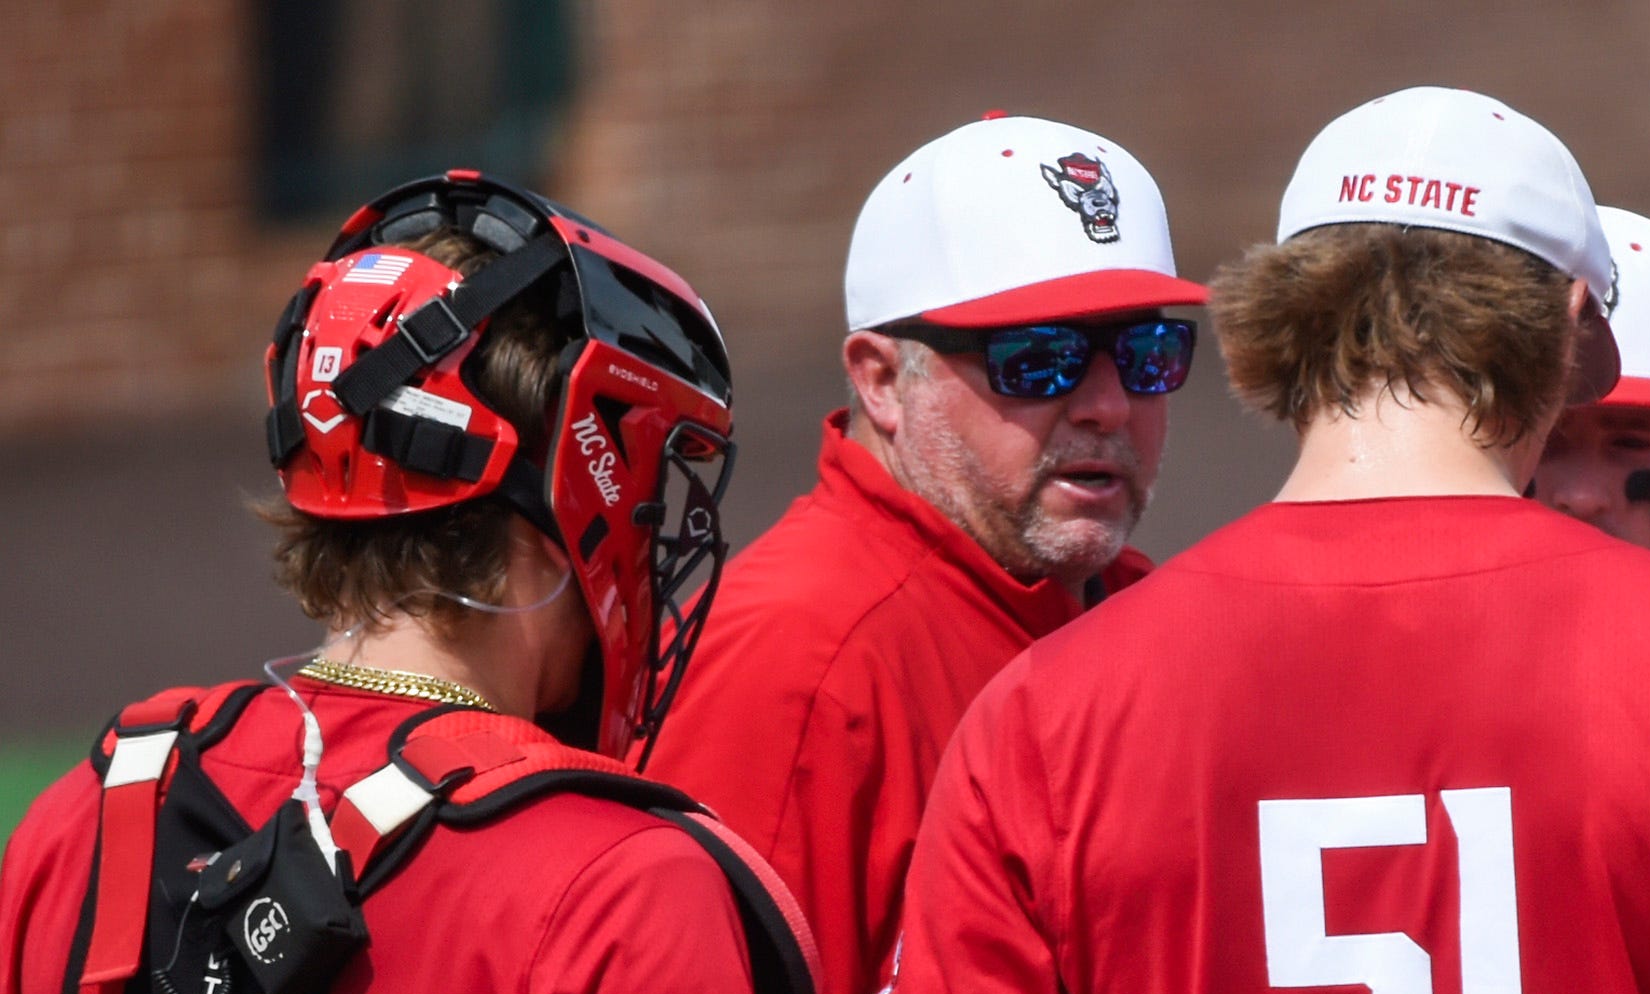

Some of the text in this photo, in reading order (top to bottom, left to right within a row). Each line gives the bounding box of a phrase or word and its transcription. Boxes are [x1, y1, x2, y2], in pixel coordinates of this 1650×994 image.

[1338, 173, 1481, 217] NC STATE
[318, 354, 336, 374] 13
[571, 412, 622, 507] NC State
